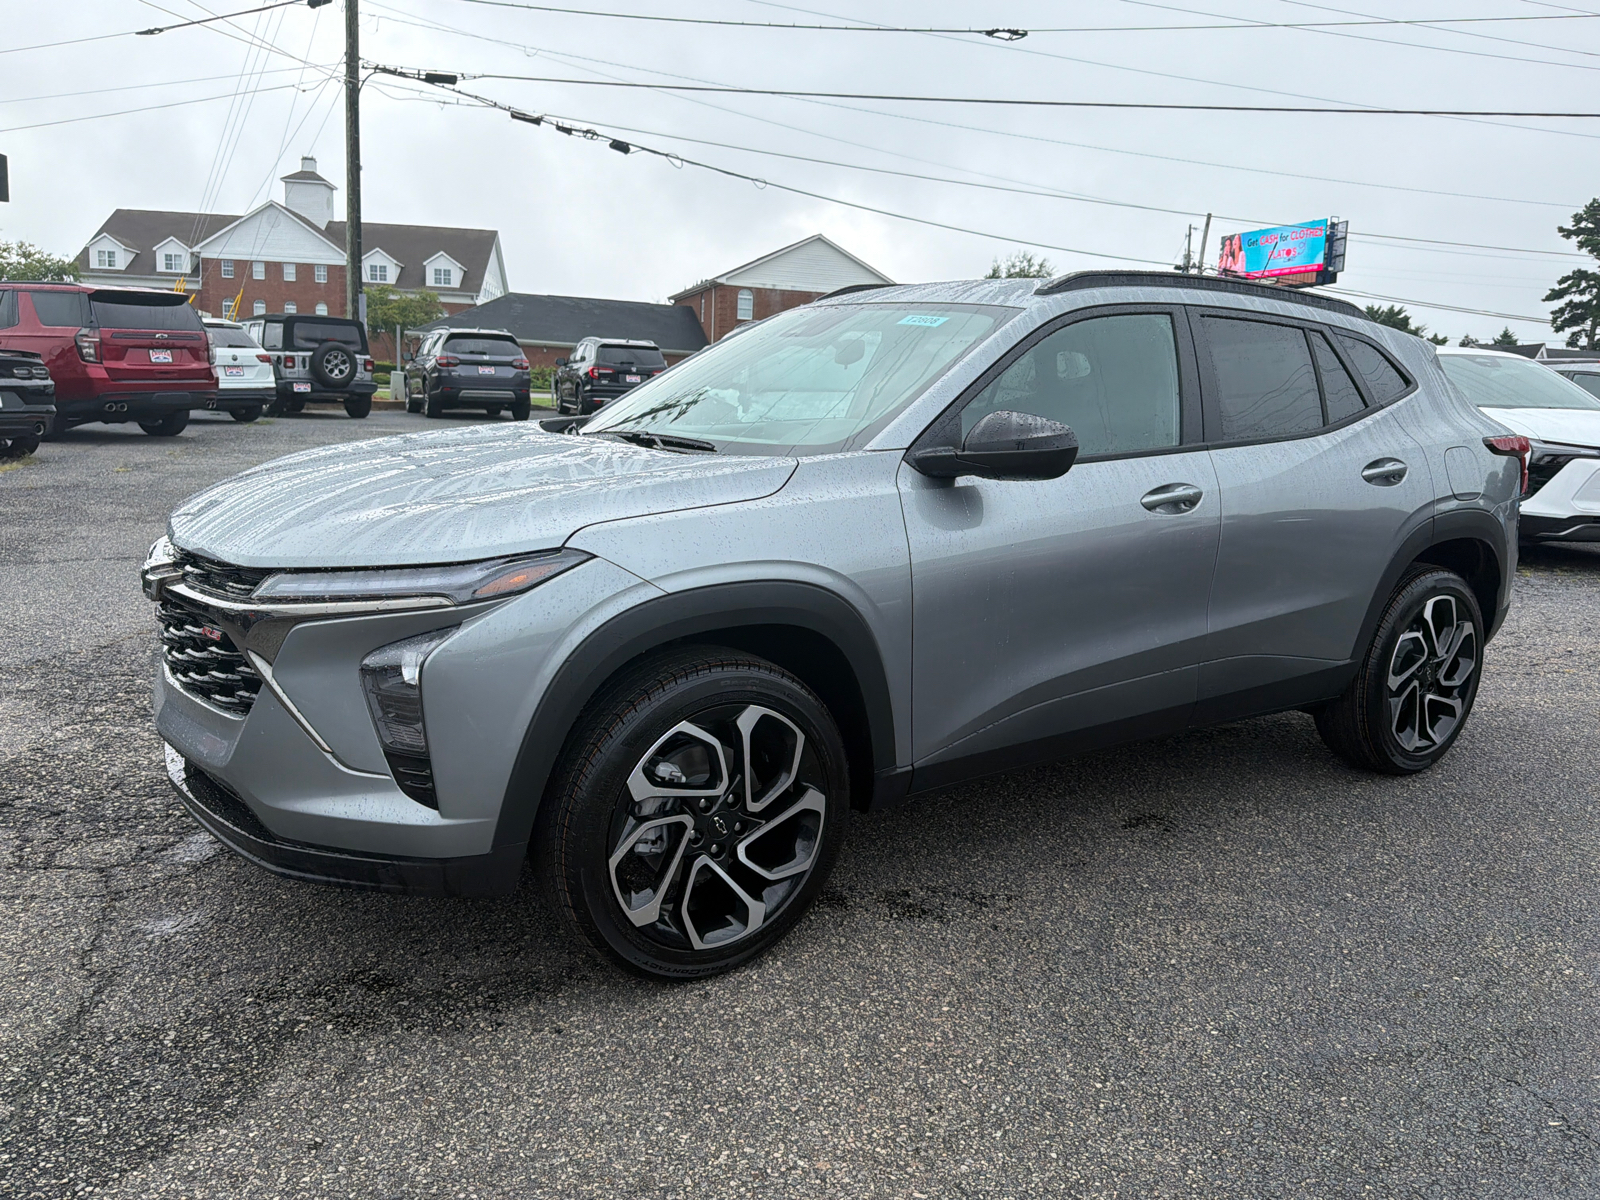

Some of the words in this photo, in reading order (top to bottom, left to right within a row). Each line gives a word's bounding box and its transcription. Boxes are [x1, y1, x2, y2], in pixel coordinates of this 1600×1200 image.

[1247, 238, 1258, 247] Get
[1259, 234, 1279, 246] CASH
[1280, 233, 1289, 242] for
[1290, 226, 1323, 240] CLOTHES
[906, 316, 940, 324] T2808
[202, 625, 222, 640] RS
